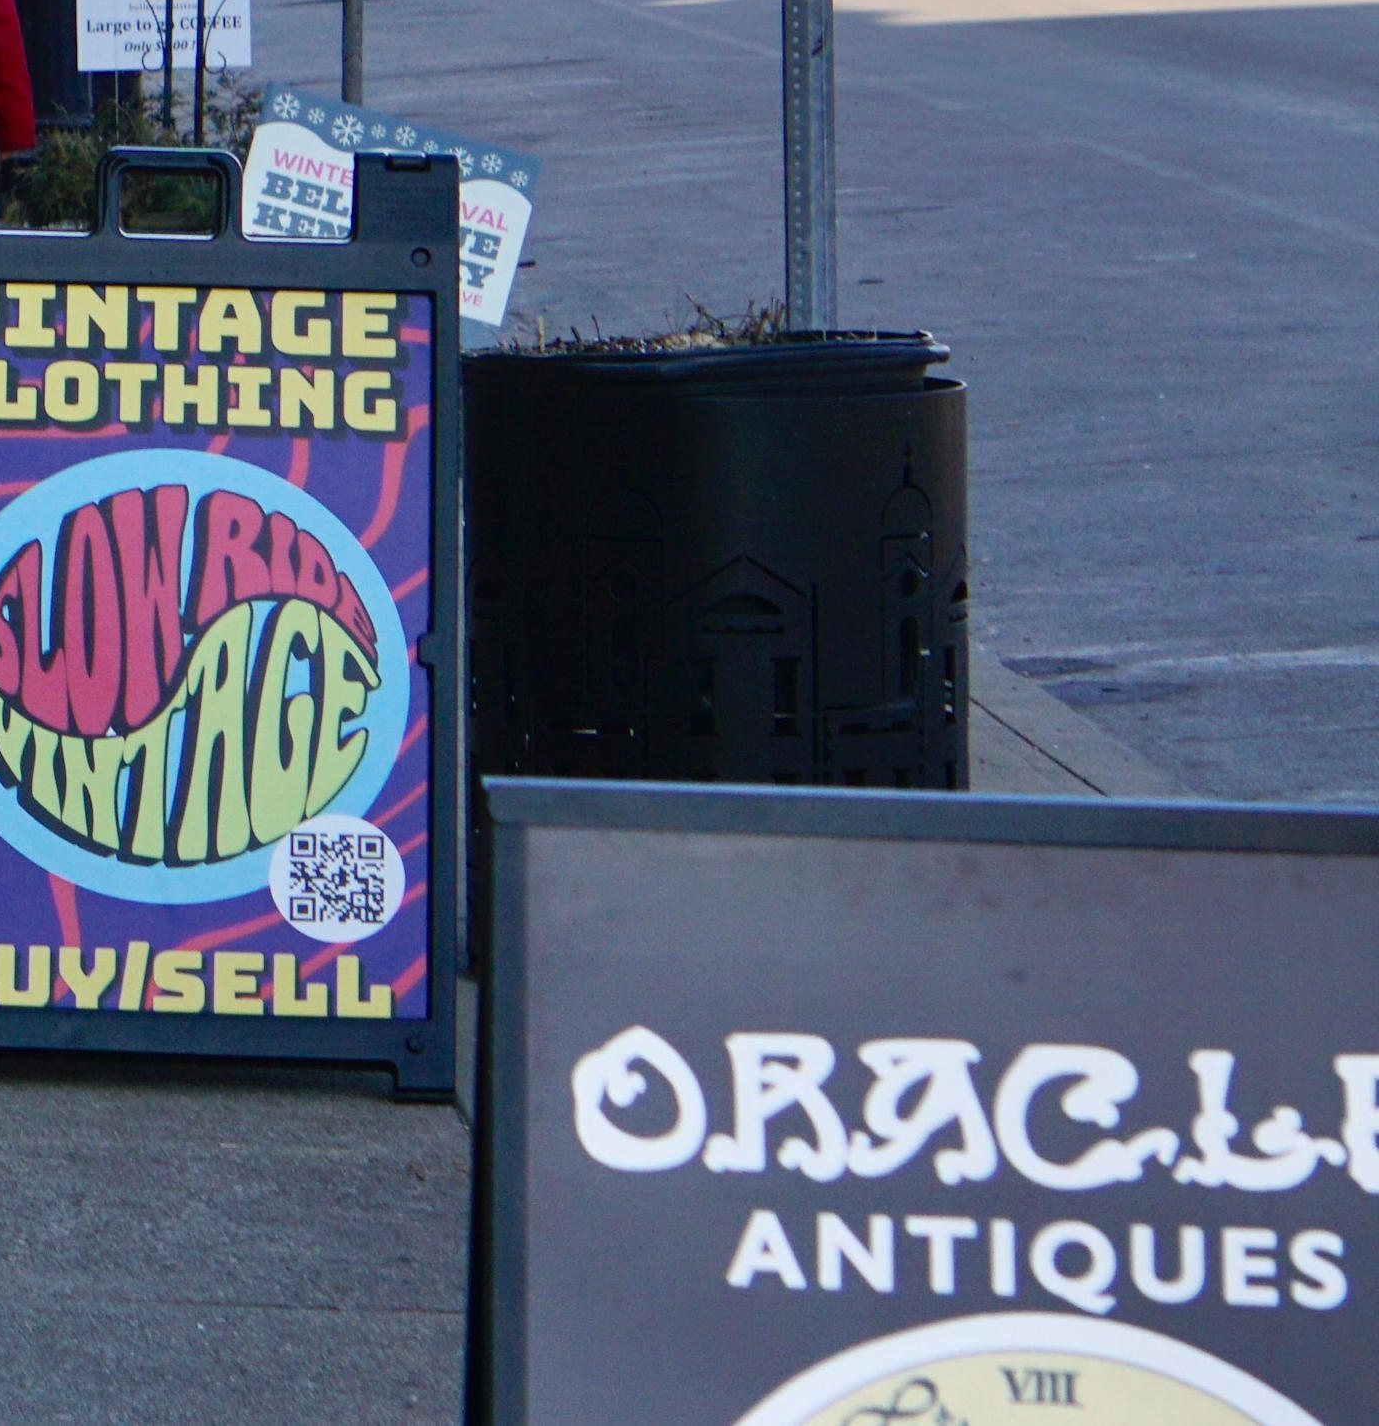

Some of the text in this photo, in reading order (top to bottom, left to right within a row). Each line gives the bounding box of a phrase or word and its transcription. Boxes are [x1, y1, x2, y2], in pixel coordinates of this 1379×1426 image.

[86, 18, 132, 35] Large
[136, 19, 152, 32] to
[124, 40, 152, 53] Only
[273, 148, 353, 188] WINTE
[195, 489, 379, 670] RIDE
[726, 1209, 1349, 1314] ANTIQUES
